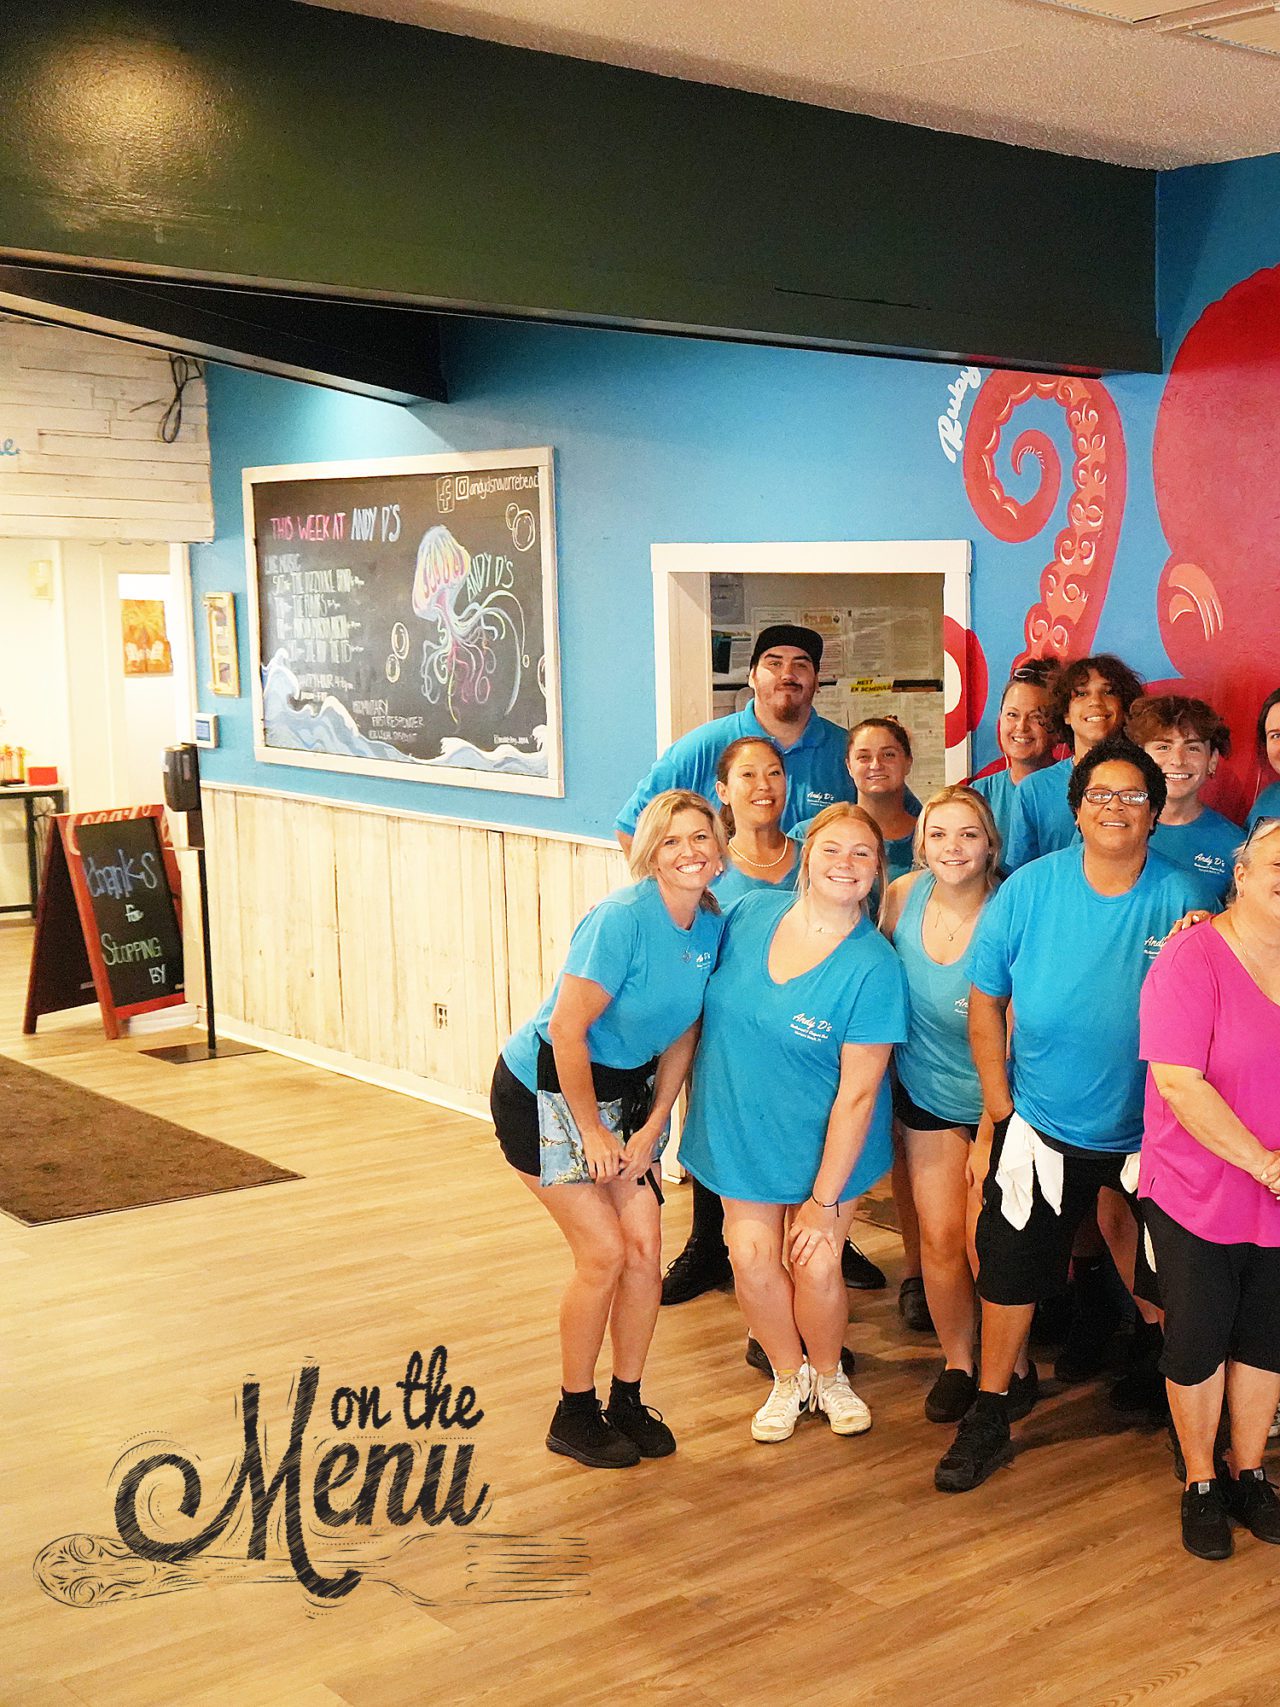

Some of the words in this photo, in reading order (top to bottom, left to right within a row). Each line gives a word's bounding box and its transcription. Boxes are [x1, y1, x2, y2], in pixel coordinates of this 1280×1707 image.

[270, 516, 294, 541] THIS
[298, 514, 330, 541] WEEK
[332, 512, 346, 541] AT
[351, 506, 378, 541] ANDY
[382, 504, 401, 542] D'S
[1194, 852, 1213, 866] Andy
[792, 1012, 816, 1030] Andy
[817, 1020, 833, 1032] D's
